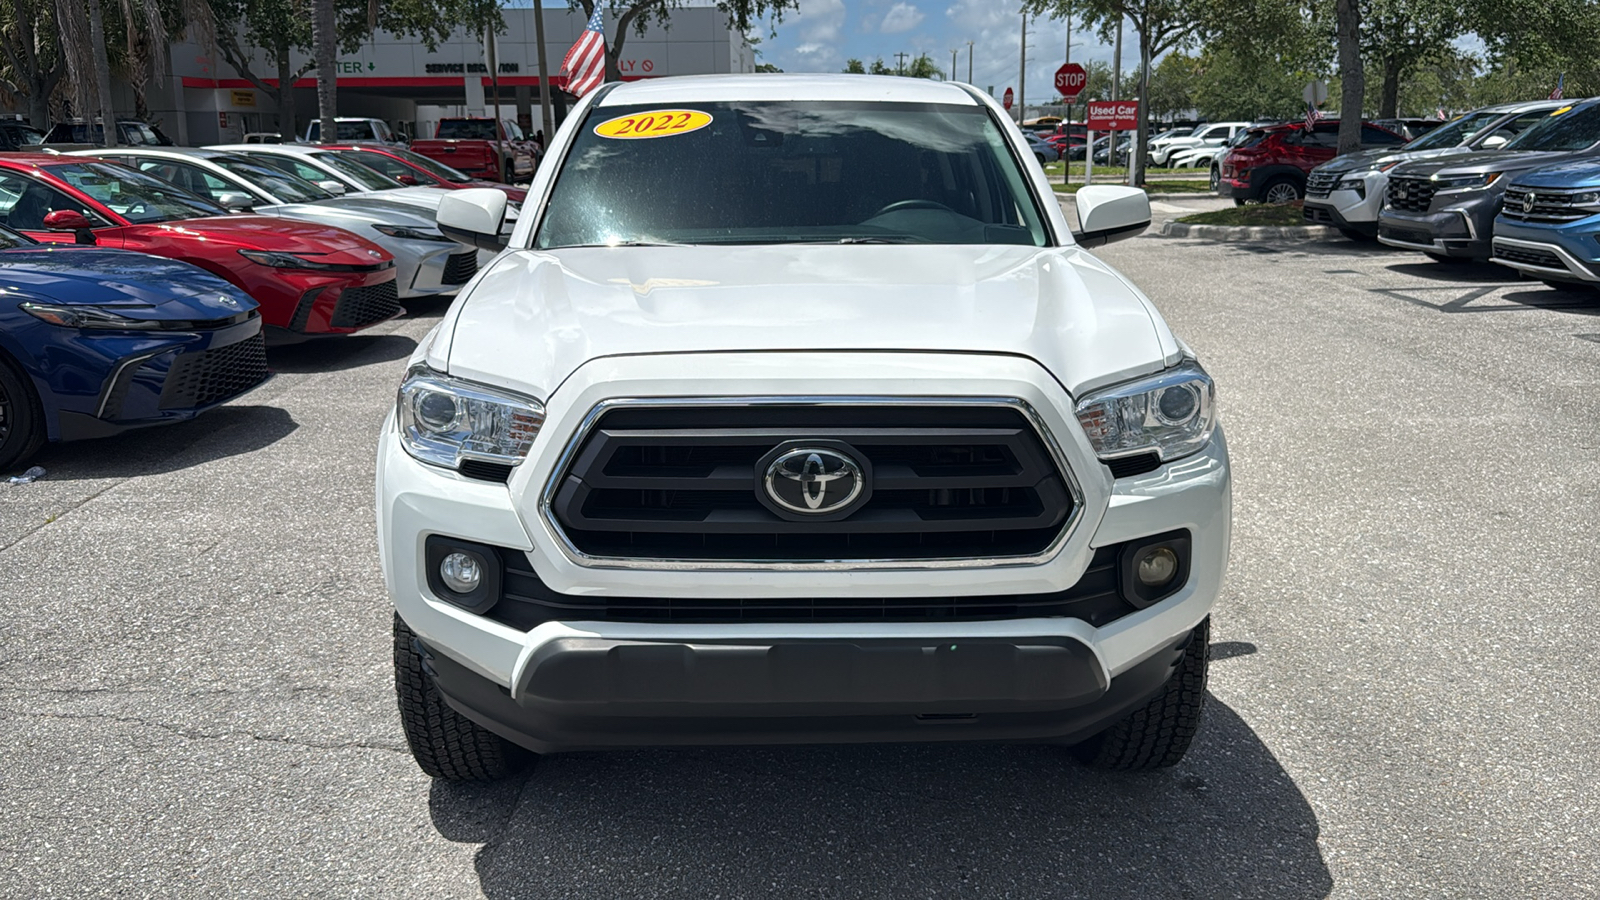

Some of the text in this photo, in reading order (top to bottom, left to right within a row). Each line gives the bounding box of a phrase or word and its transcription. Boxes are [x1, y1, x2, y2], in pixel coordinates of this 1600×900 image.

[336, 61, 363, 73] TER
[425, 63, 519, 73] SERVICE RECTION
[617, 60, 636, 72] LY
[1056, 73, 1085, 87] STOP
[1090, 105, 1137, 116] Used Car
[613, 113, 692, 135] 2022
